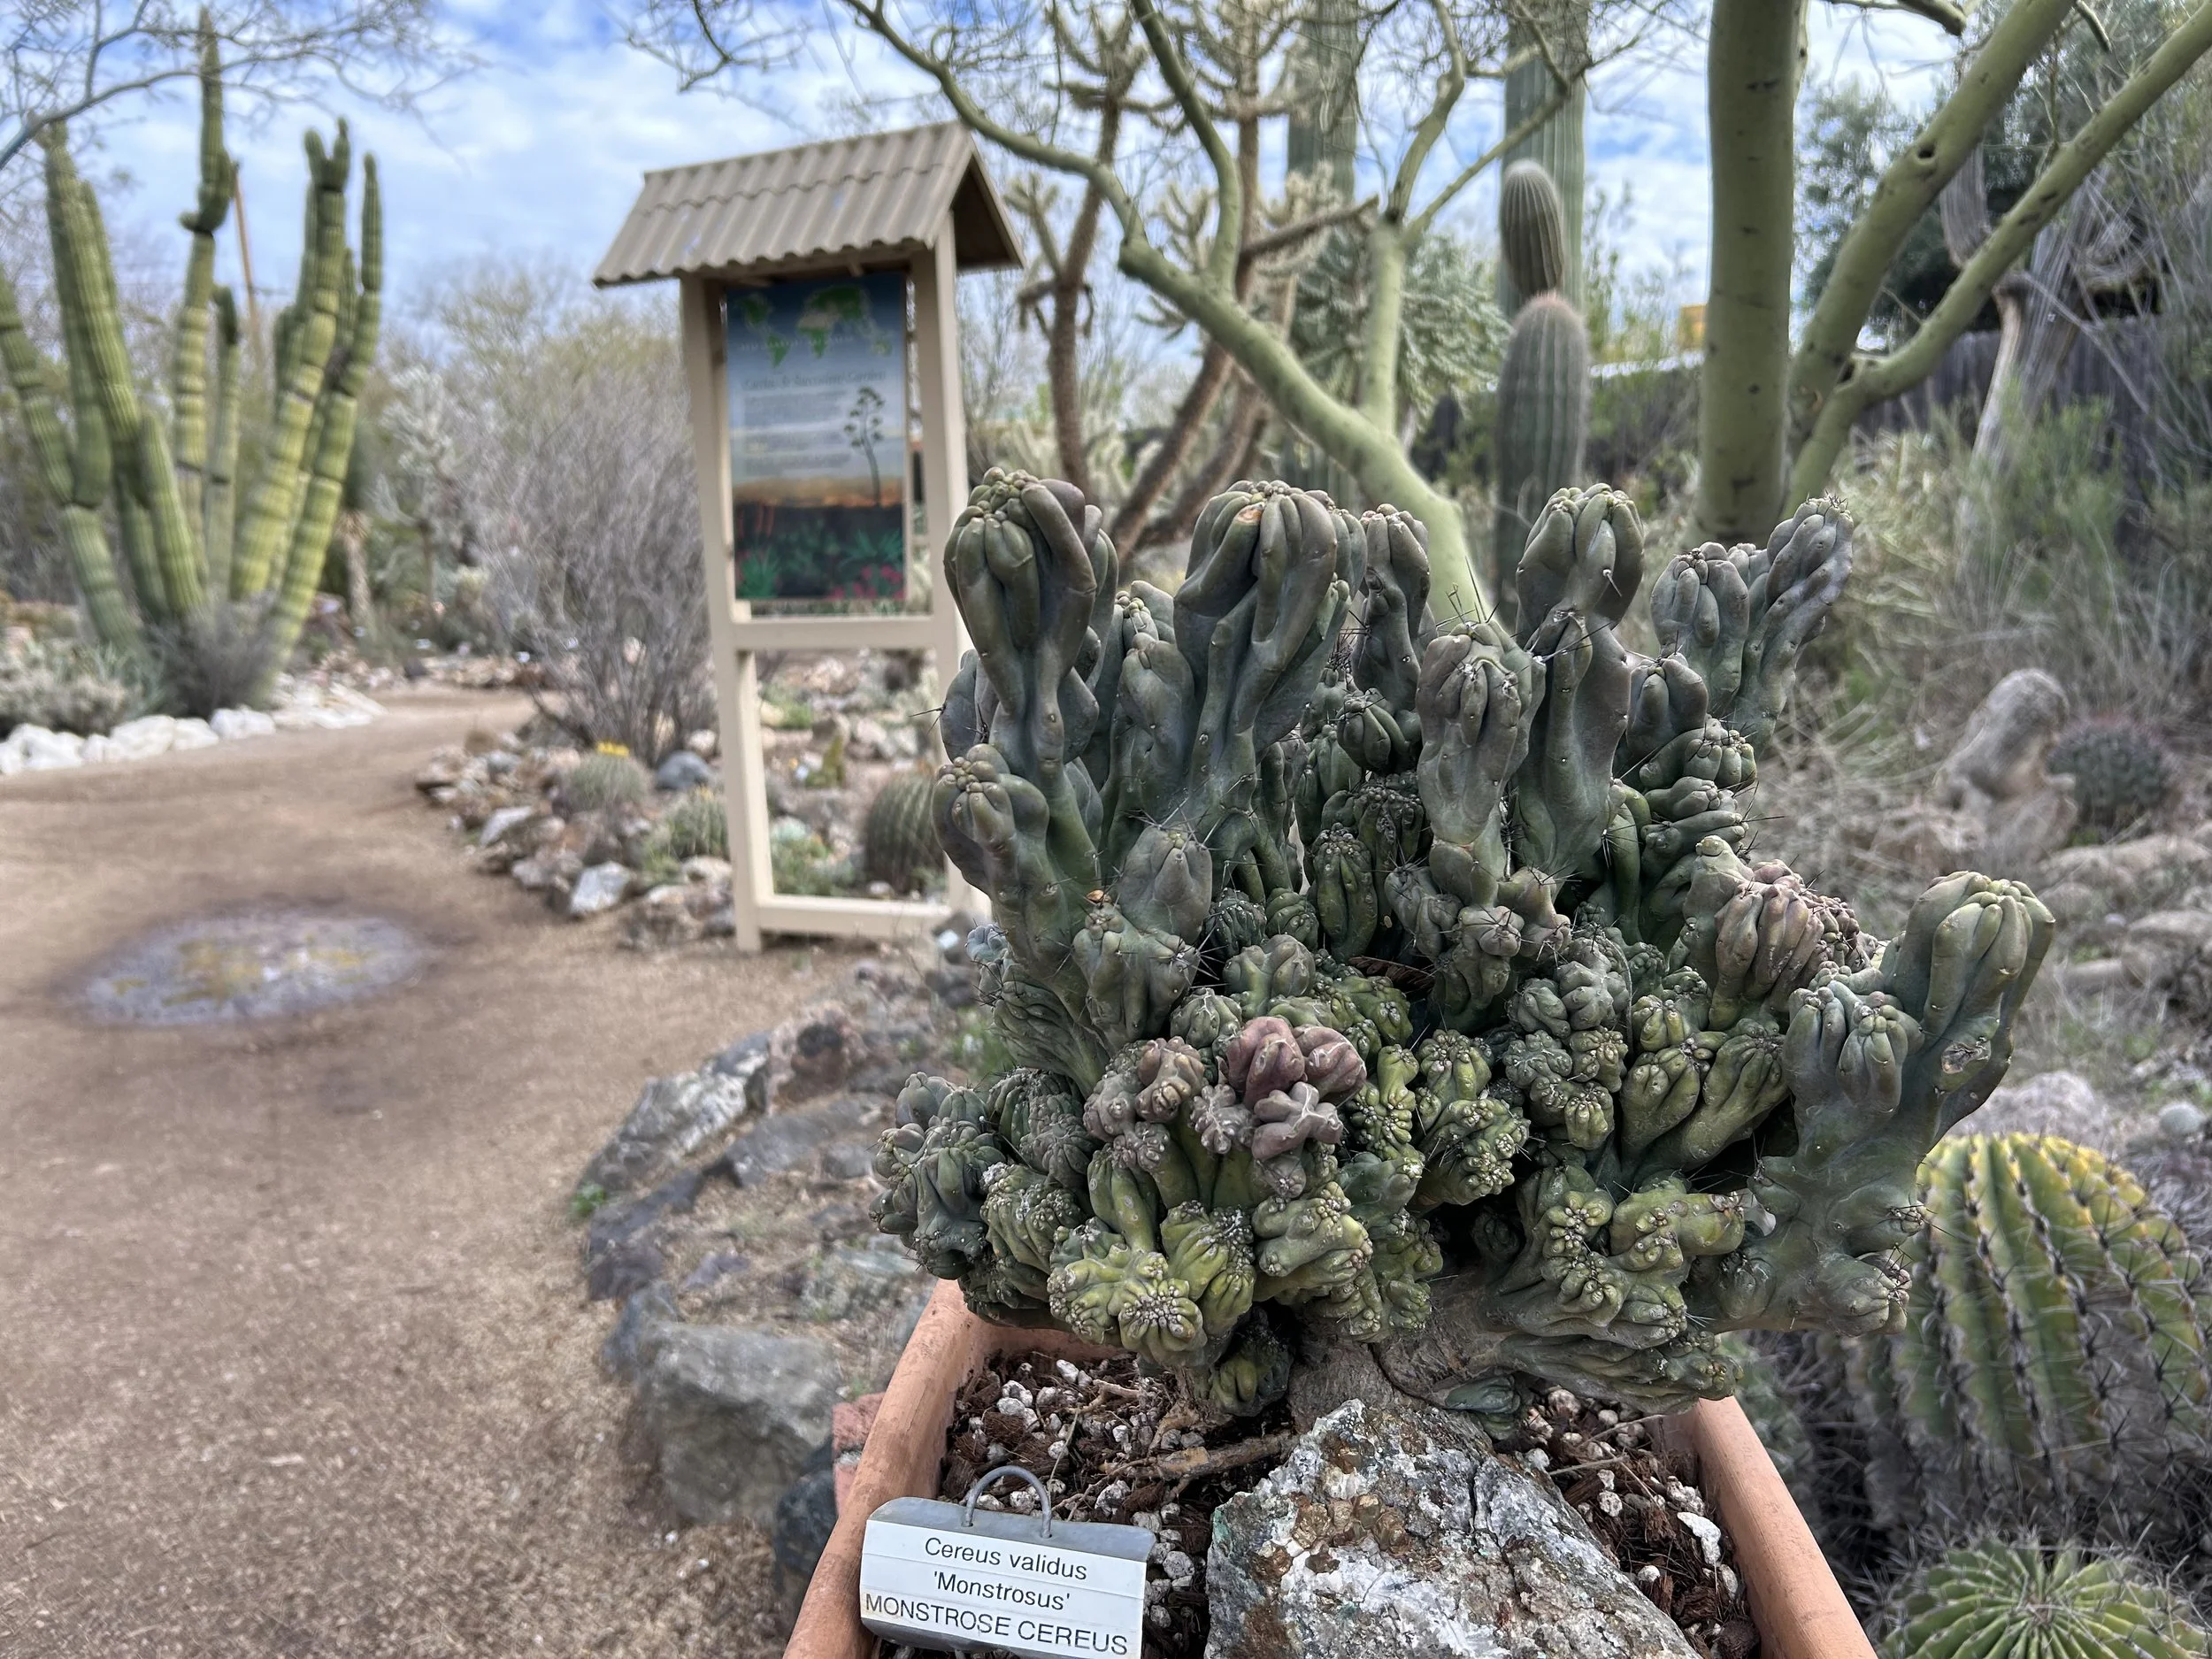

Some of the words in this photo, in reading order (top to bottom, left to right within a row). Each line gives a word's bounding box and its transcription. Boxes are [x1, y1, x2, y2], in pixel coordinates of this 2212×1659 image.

[925, 1538, 1001, 1565] Cereus
[1010, 1555, 1087, 1580] validus
[933, 1571, 1071, 1610] 'Monstrosus'
[865, 1594, 1011, 1636] MONSTROSE
[1018, 1620, 1129, 1655] CEREUS
